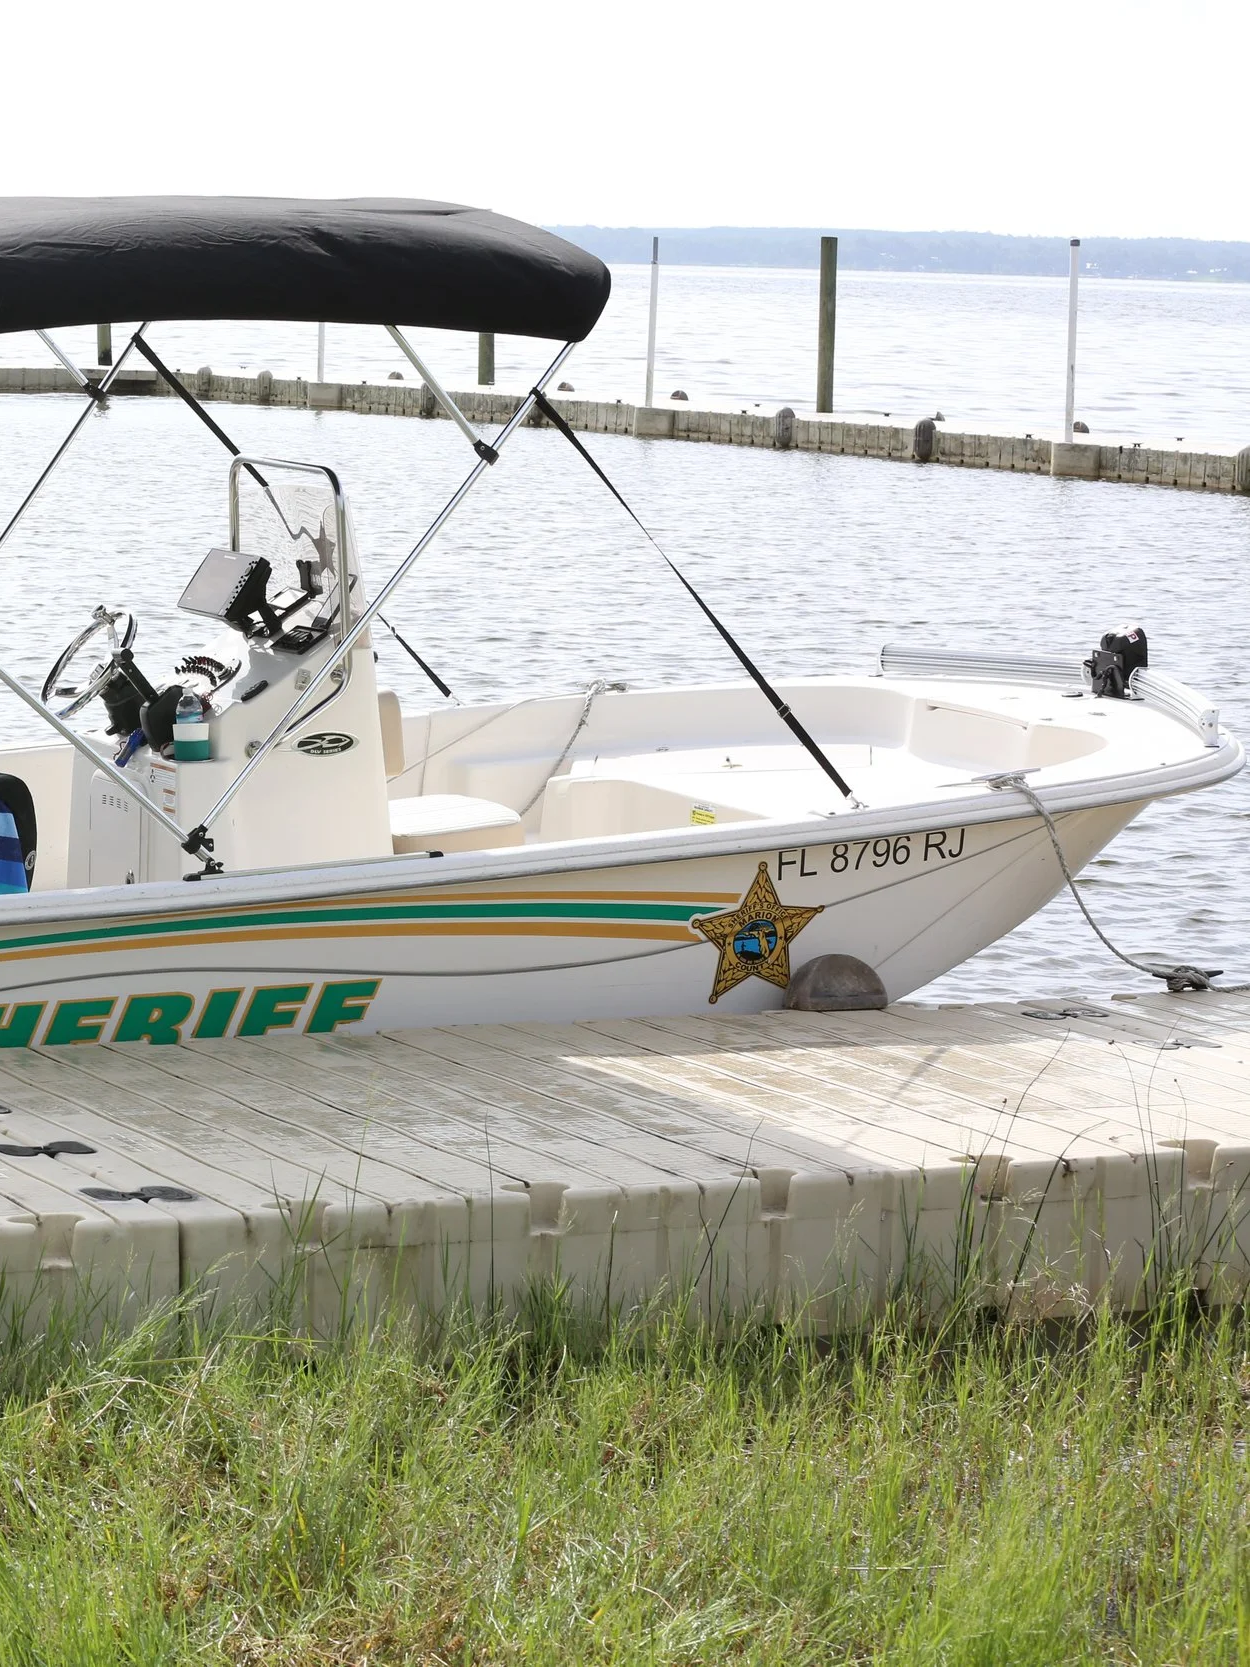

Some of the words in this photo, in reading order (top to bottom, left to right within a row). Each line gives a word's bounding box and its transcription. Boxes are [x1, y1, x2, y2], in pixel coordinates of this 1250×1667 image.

[778, 849, 817, 881] FL
[830, 835, 911, 873] 8796
[923, 828, 965, 861] RJ
[738, 911, 779, 928] MARION
